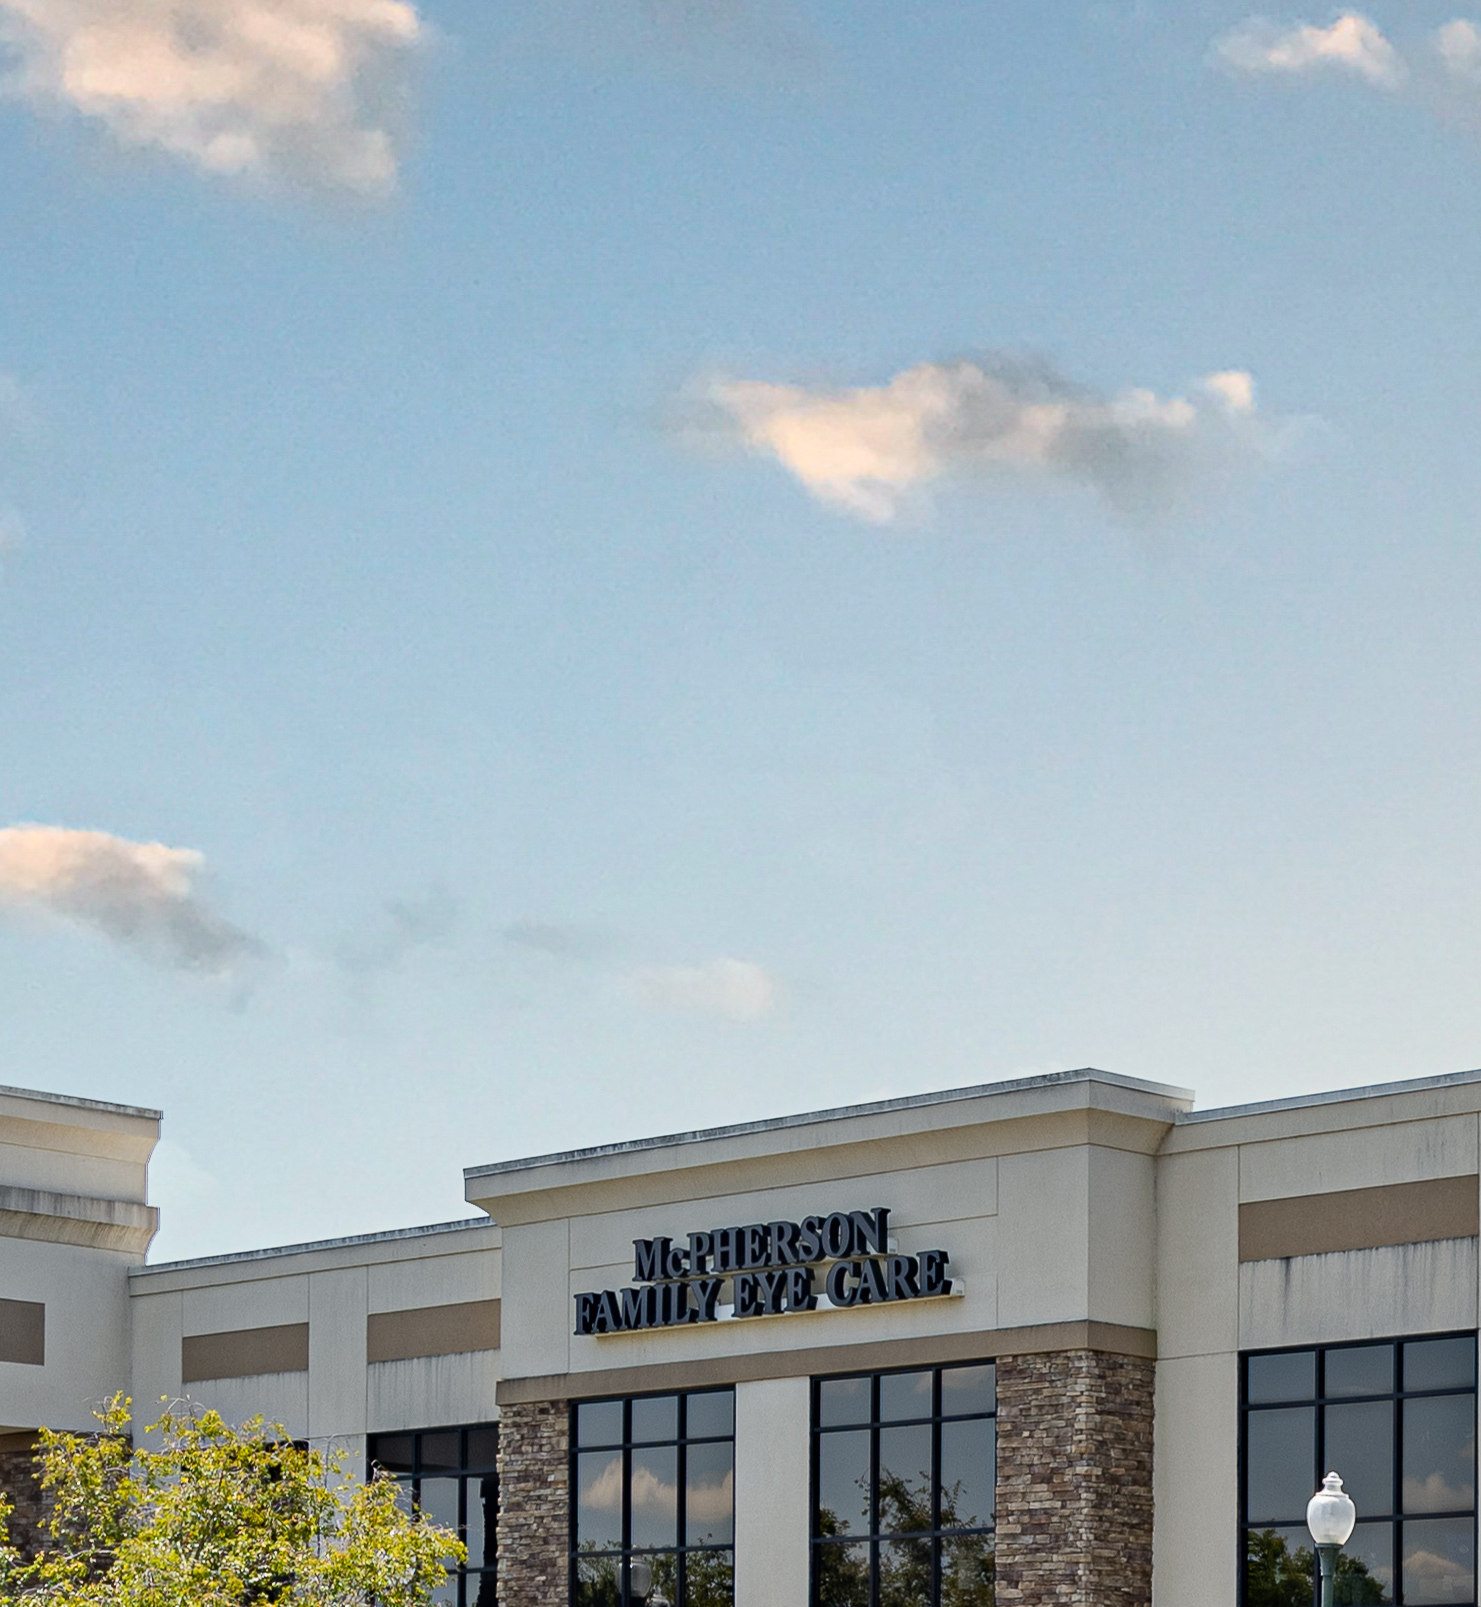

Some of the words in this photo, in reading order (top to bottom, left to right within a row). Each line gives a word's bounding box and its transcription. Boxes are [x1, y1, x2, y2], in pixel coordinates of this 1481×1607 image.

[632, 1207, 891, 1281] McPHERSON
[574, 1278, 725, 1335] FAMILY
[731, 1266, 818, 1318] EYE
[826, 1250, 952, 1307] CARE
